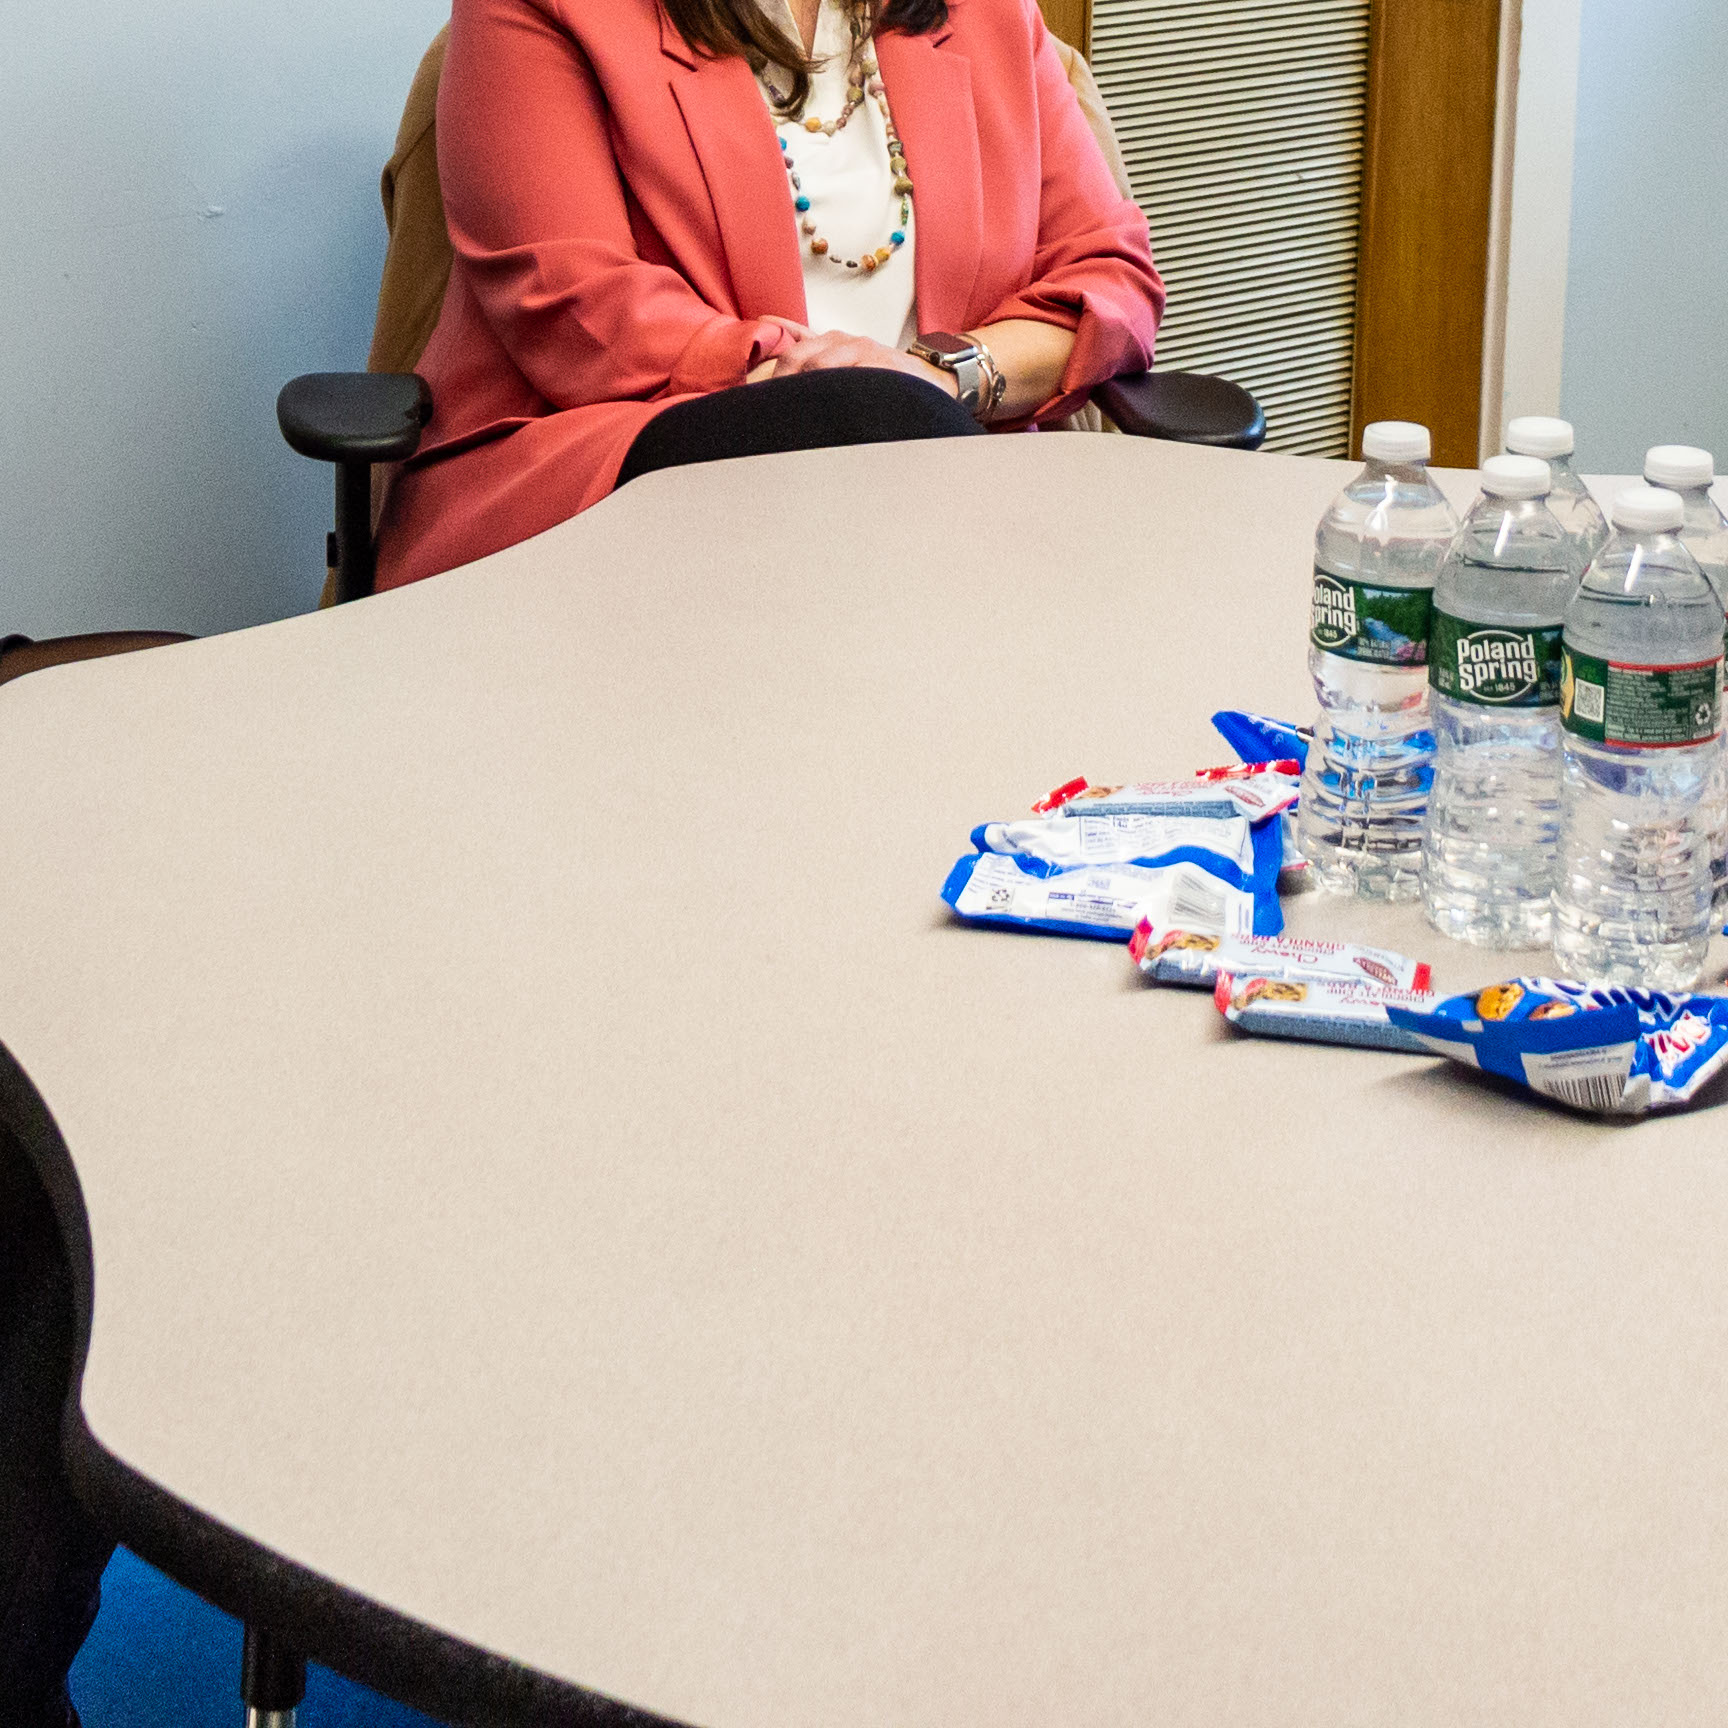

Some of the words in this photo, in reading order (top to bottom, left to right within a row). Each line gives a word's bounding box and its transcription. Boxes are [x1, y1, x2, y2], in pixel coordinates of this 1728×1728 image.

[1313, 583, 1356, 614] oland
[1456, 633, 1536, 665] Poland
[1458, 657, 1539, 692] Spring
[1250, 946, 1319, 965] Chewy
